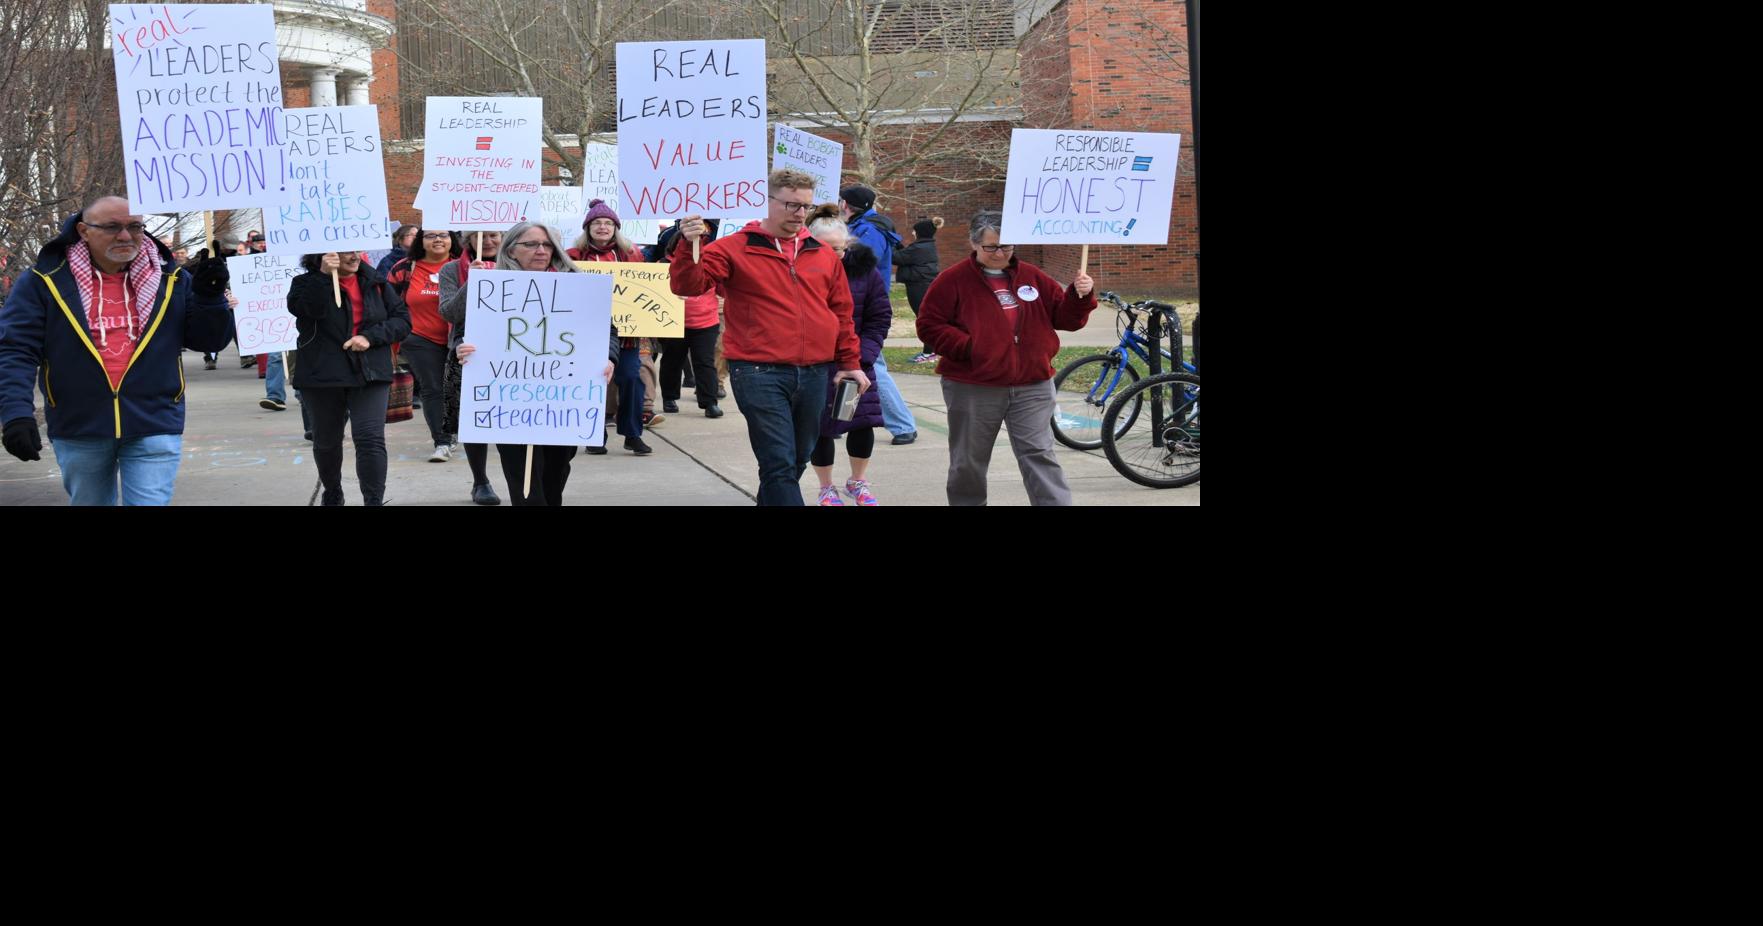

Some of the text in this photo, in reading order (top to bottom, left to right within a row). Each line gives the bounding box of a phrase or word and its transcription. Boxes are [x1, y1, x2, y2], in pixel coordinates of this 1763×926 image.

[118, 6, 190, 57] real
[148, 42, 274, 77] LEADERS
[653, 49, 739, 82] REAL
[137, 81, 280, 113] protect the
[462, 101, 503, 114] REAL
[619, 95, 761, 122] LEADERS
[135, 107, 286, 151] ACADEMIC
[285, 112, 355, 139] REAL
[439, 118, 527, 129] LEADERSHIP
[289, 135, 376, 156] ADERS
[779, 128, 803, 147] REAL
[1055, 134, 1135, 153] RESPONSIBLE
[436, 156, 535, 169] INVESTING IN
[643, 139, 747, 170] VALUE
[789, 147, 828, 168] LEADERS
[1042, 156, 1128, 172] LEADERSHIP
[470, 170, 494, 180] THE
[301, 180, 348, 200] take
[431, 182, 539, 194] STUDENT-CENTERED
[621, 178, 766, 216] WORKERS
[1020, 177, 1156, 214] HONEST
[269, 228, 289, 245] in
[299, 228, 311, 241] a
[254, 256, 287, 268] REAL
[260, 284, 283, 295] CUT
[477, 278, 573, 315] REAL
[633, 293, 678, 328] FIRST
[505, 317, 575, 357] R1s
[490, 356, 574, 380] value:
[498, 379, 603, 404] research
[494, 404, 599, 440] teaching
